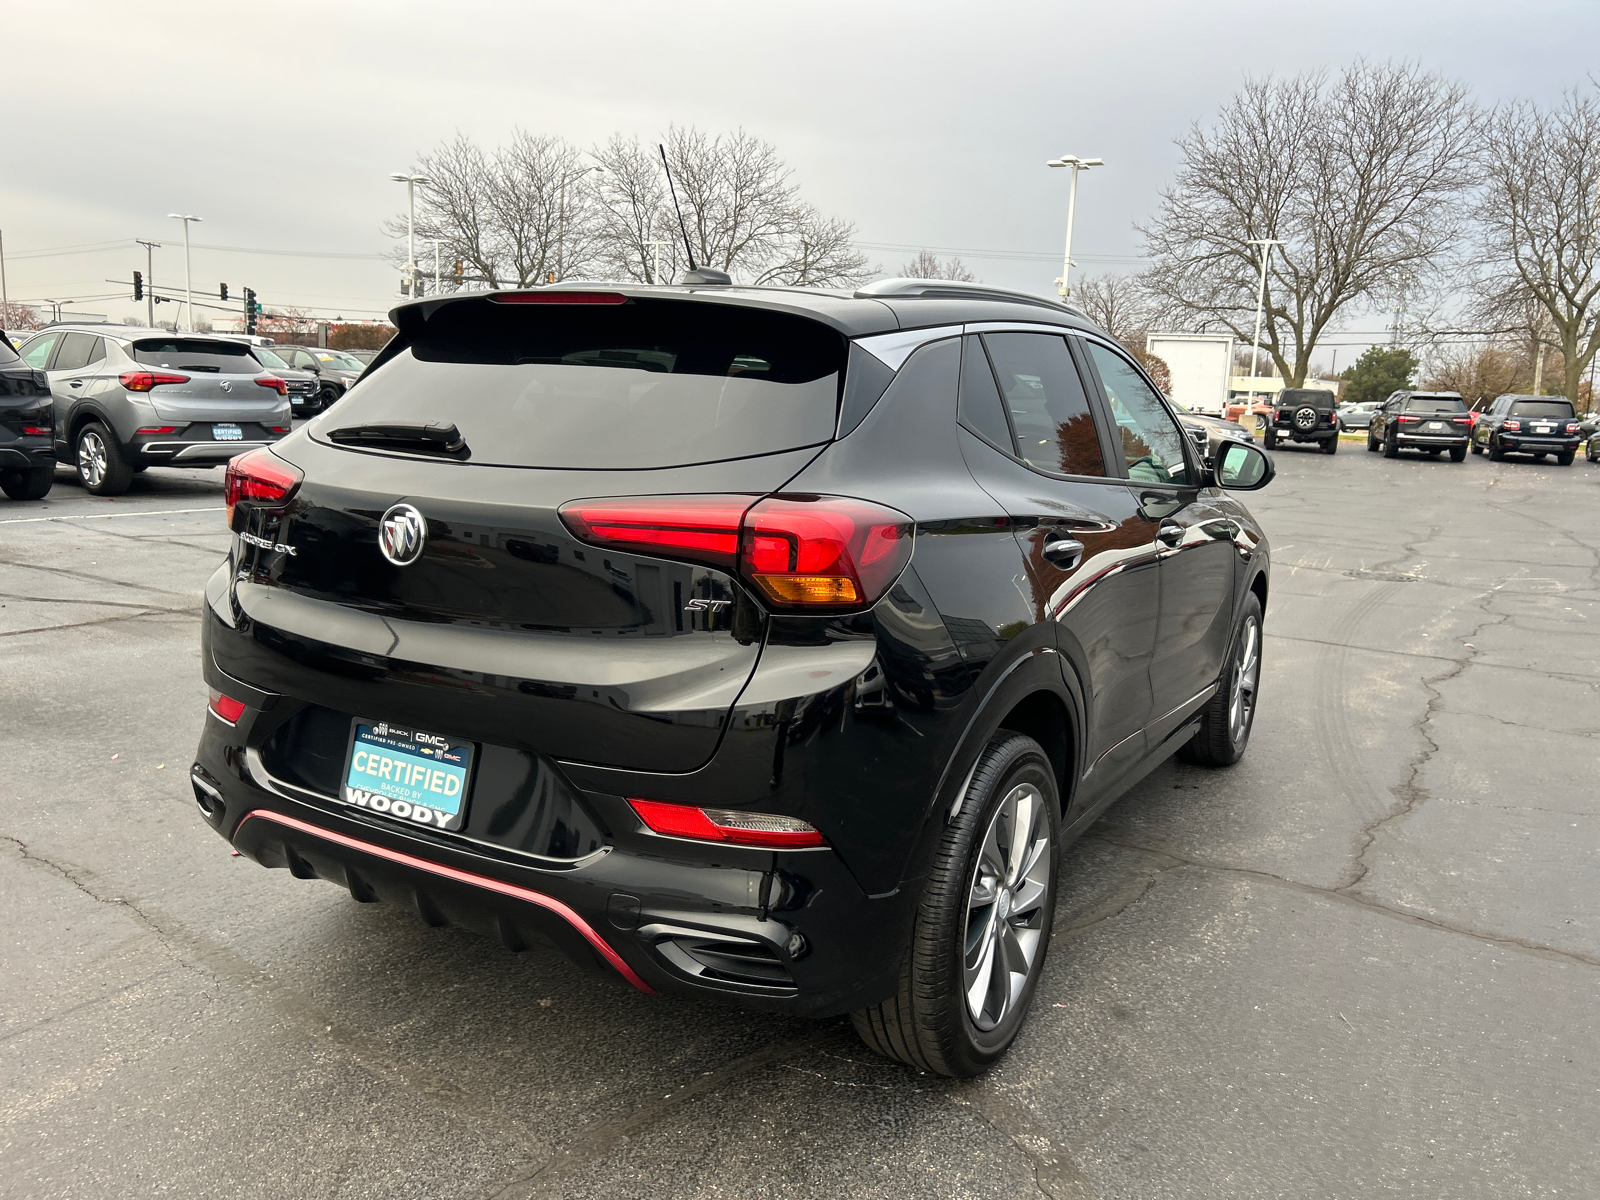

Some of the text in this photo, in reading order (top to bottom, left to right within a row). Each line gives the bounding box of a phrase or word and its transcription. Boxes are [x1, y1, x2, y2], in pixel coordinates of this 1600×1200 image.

[274, 543, 298, 556] GX
[684, 598, 732, 612] ST
[361, 733, 387, 743] CERTIFIED
[388, 728, 446, 747] BUICK GMC
[443, 753, 461, 762] GMC
[353, 751, 461, 797] CERTIFIED
[381, 782, 423, 800] BACKED BY
[345, 786, 455, 829] WOODY
